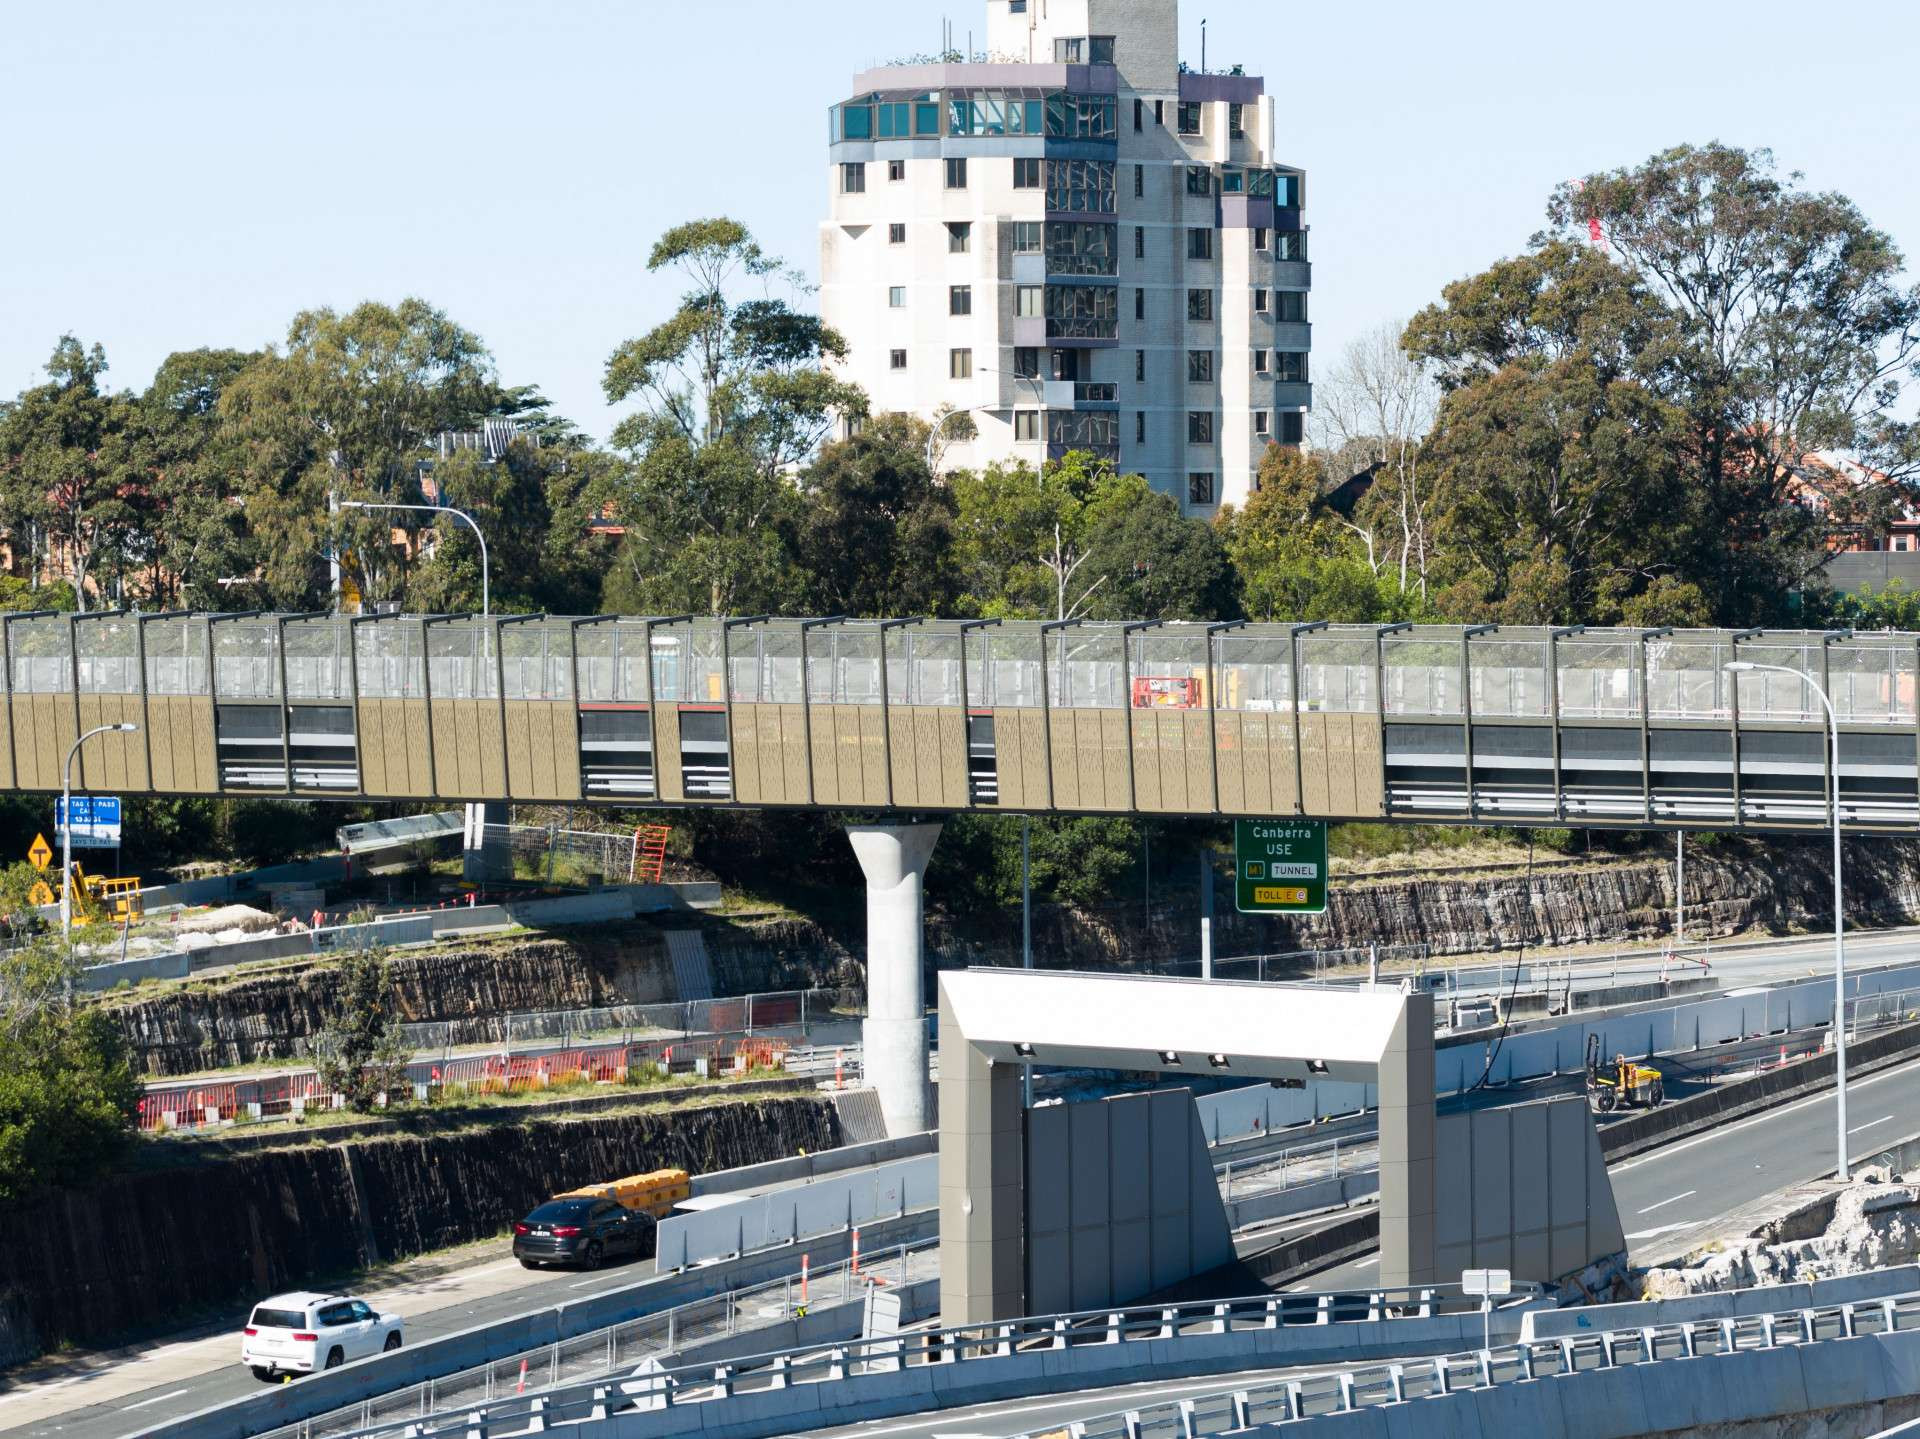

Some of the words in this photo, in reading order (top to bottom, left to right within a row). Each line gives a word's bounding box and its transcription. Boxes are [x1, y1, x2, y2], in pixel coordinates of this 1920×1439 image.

[1252, 827, 1311, 838] Canberra
[1266, 843, 1292, 855] USE
[1274, 866, 1314, 875] TUNNEL
[1257, 891, 1282, 900] TOLL
